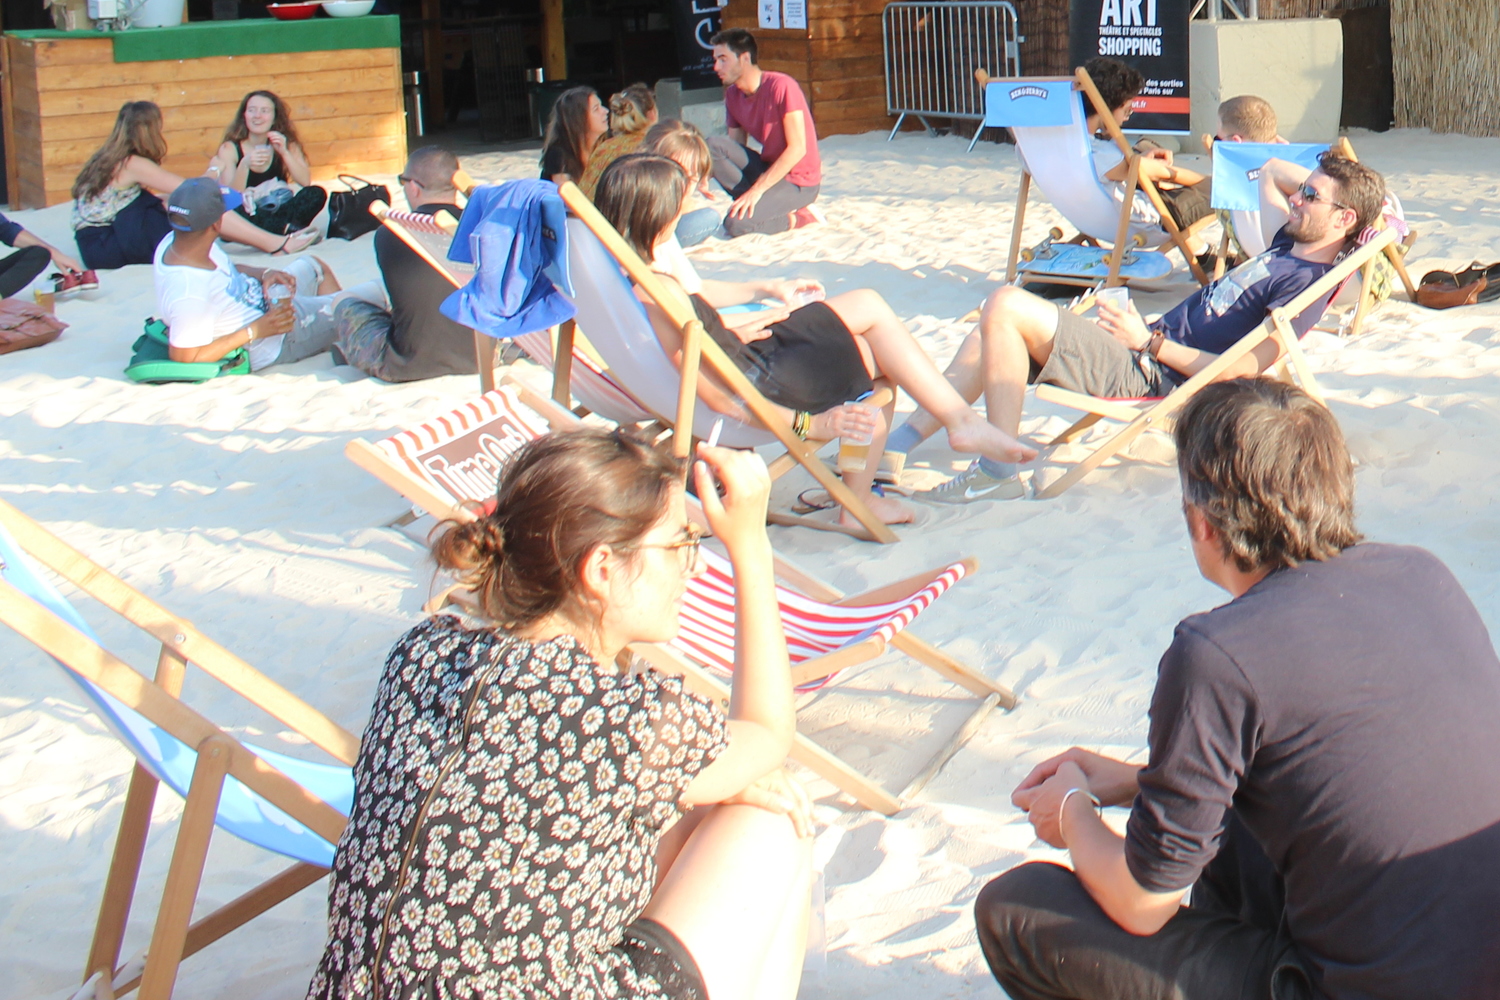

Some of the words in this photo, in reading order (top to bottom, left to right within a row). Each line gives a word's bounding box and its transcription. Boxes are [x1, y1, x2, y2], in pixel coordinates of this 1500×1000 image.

[1122, 27, 1130, 36] ET
[1129, 26, 1162, 37] SPECTACLES
[1098, 35, 1162, 56] SHOPPING
[1145, 78, 1158, 87] des
[1160, 79, 1184, 88] sorties
[1143, 87, 1161, 96] Paris
[1162, 88, 1174, 96] sur
[1131, 100, 1147, 108] ut.fr
